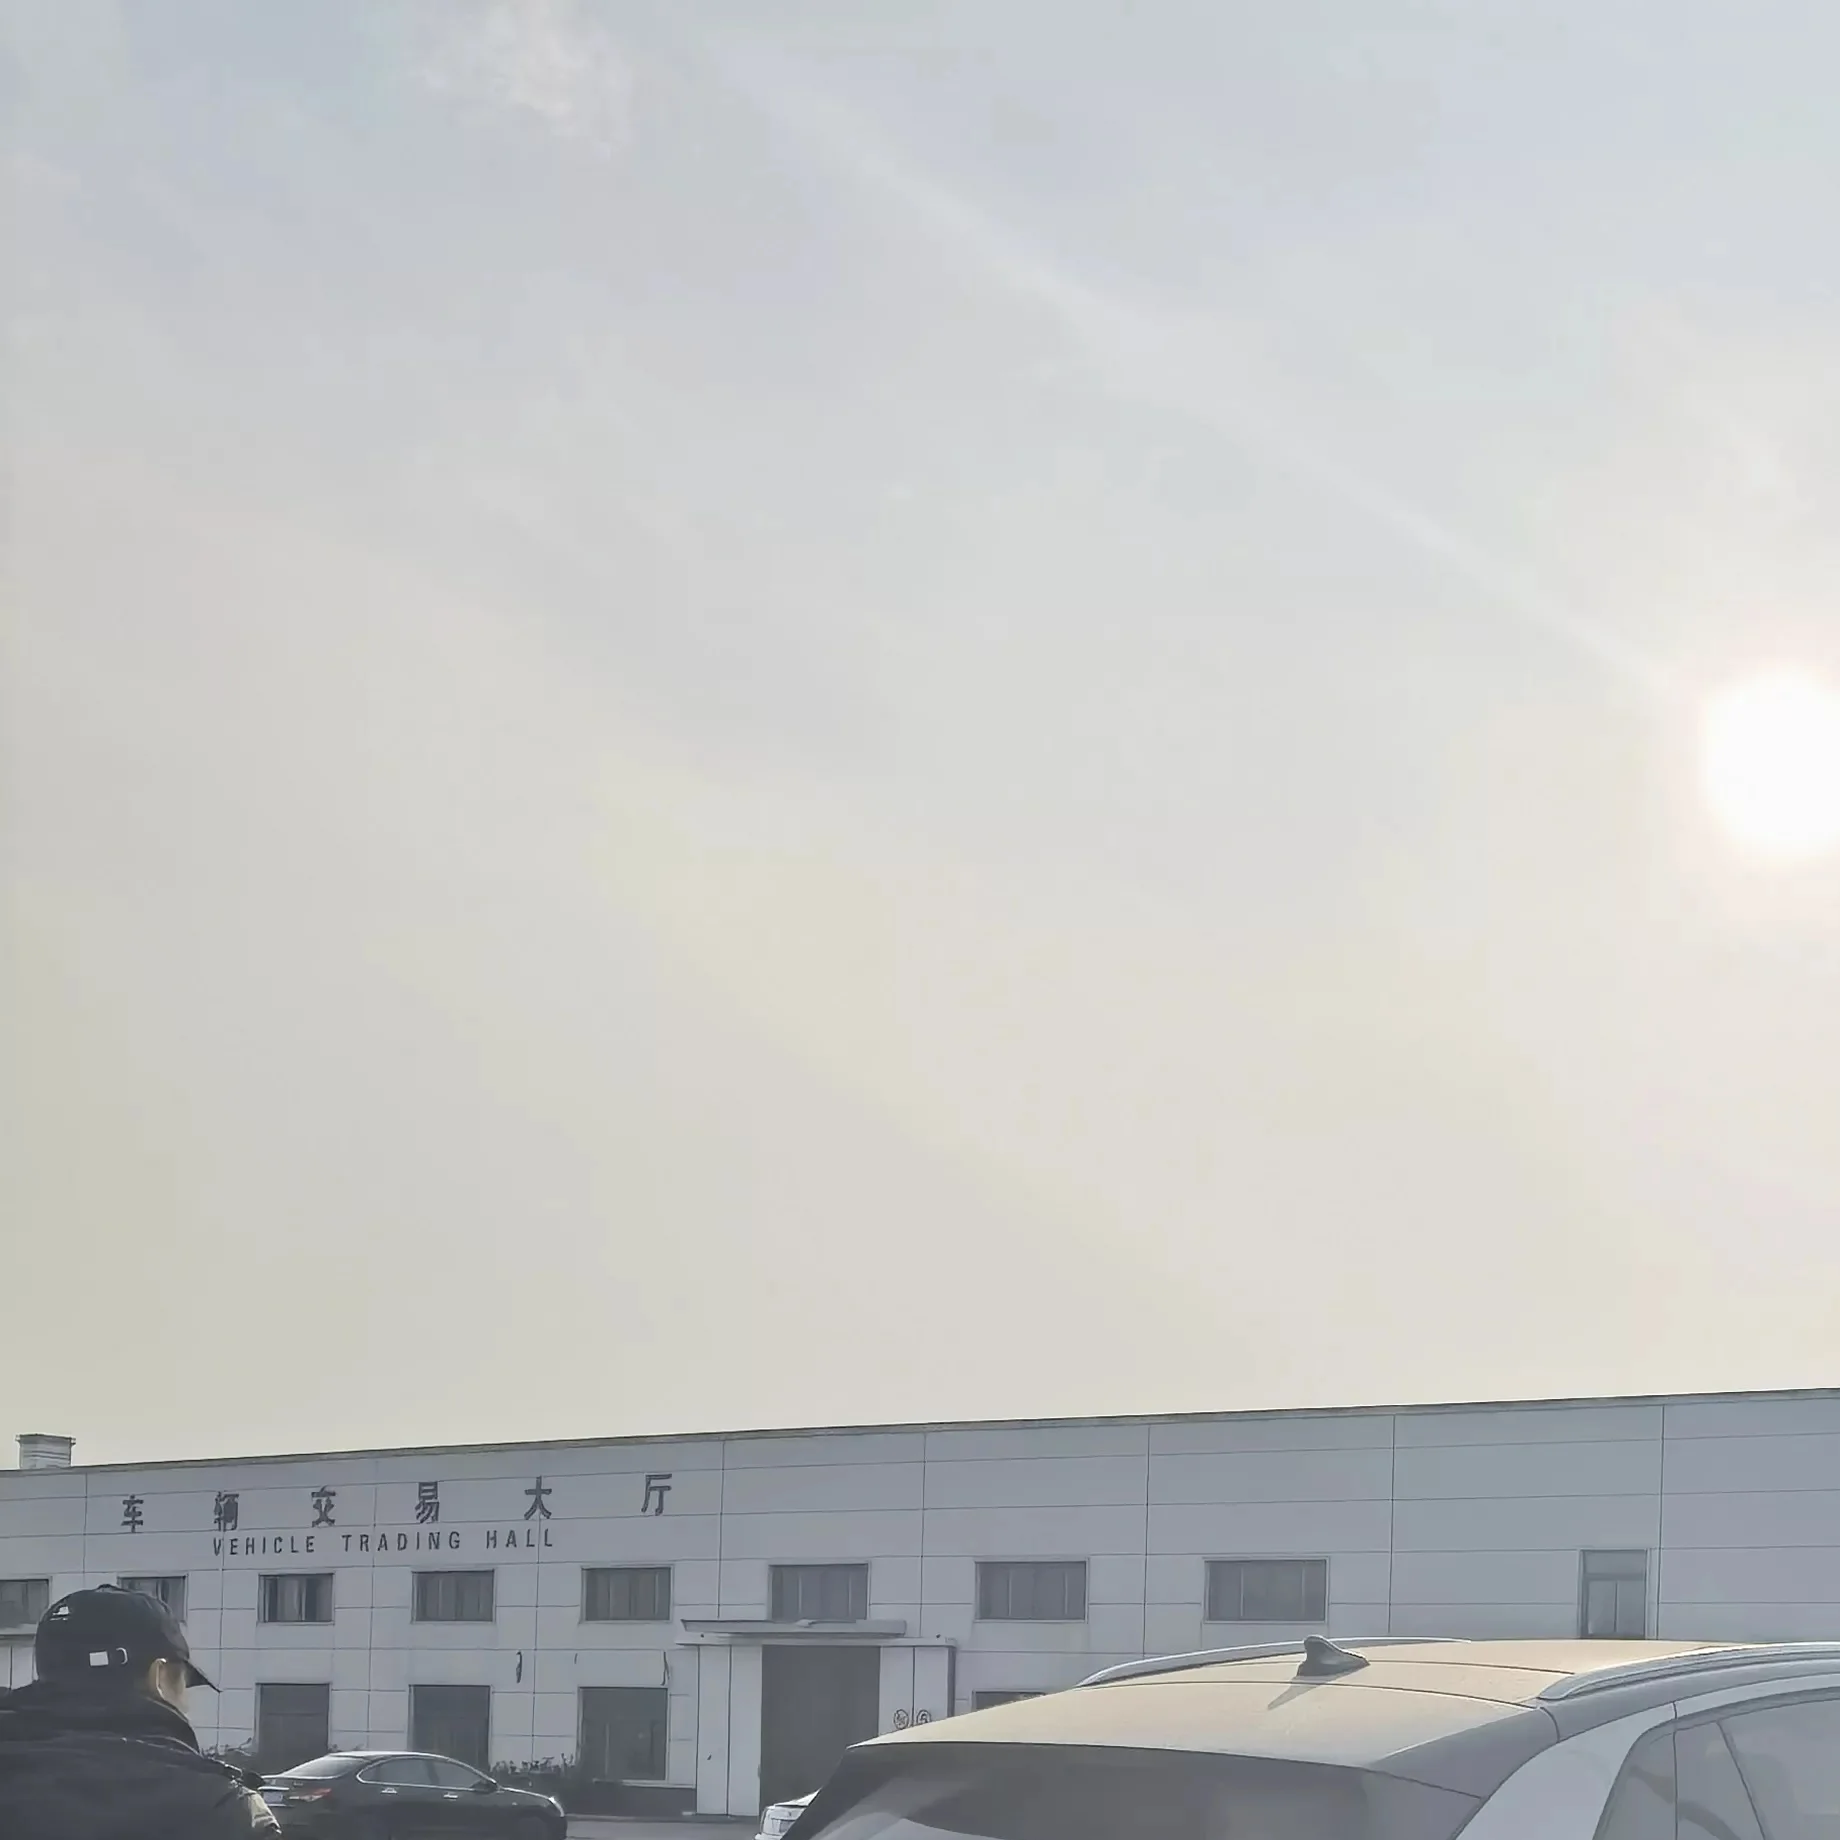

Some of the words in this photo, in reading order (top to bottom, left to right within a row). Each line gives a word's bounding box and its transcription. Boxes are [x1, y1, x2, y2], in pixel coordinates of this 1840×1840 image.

[121, 1473, 673, 1533] 车辆交易大厅
[213, 1535, 315, 1556] VEHICLE
[341, 1530, 461, 1552] TRADING
[486, 1528, 553, 1549] HALL
